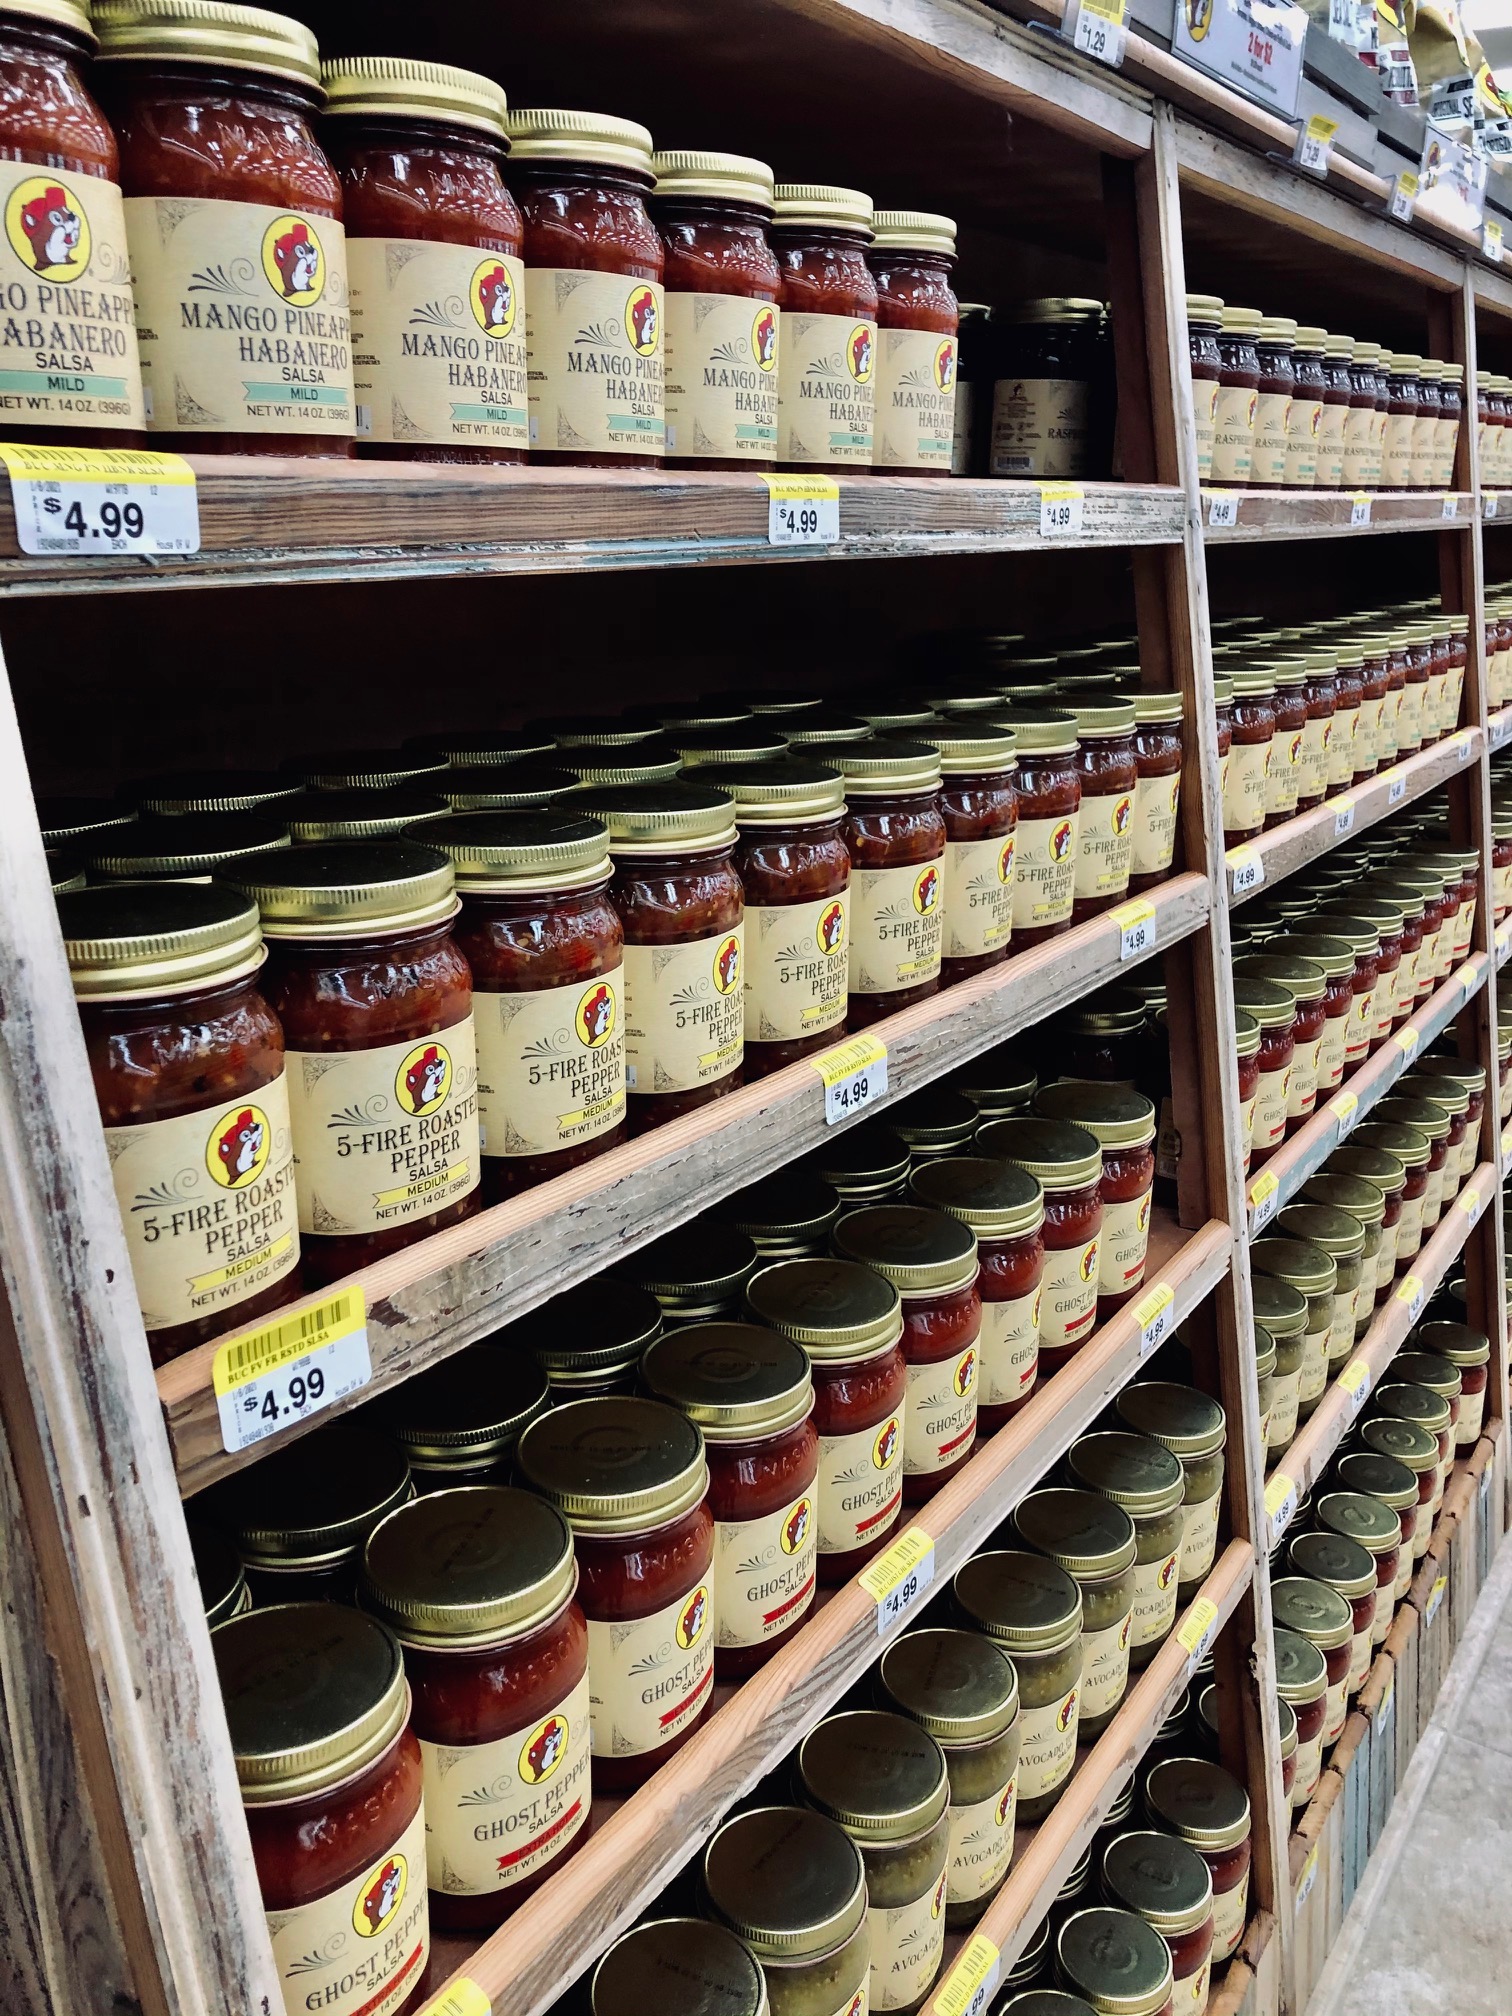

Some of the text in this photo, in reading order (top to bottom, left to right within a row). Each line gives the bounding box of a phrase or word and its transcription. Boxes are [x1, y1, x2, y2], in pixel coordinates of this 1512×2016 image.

[1082, 26, 1106, 53] $1.29
[180, 302, 278, 333] MANGO
[239, 336, 348, 371] HABANERO
[402, 333, 480, 360] MANGO
[35, 352, 94, 372] SALSA
[567, 351, 631, 376] MANGO
[47, 376, 85, 392] MILD
[282, 366, 326, 384] SALSA
[703, 367, 756, 390] MANGO
[290, 387, 319, 401] MILD
[481, 390, 513, 405] SALSA
[800, 380, 851, 401] MANGO
[892, 391, 937, 410] MANGO
[26, 397, 55, 411] WT.
[58, 399, 73, 411] 14
[247, 405, 272, 417] NET
[275, 405, 296, 418] WT.
[298, 407, 309, 418] 14
[487, 408, 508, 420] MILD
[631, 403, 656, 416] SALSA
[452, 423, 502, 435] NET WT. 14
[636, 419, 652, 430] MILD
[755, 413, 773, 425] SALSA
[849, 422, 868, 433] SALSA
[608, 432, 625, 442] NET
[736, 440, 750, 449] NET
[829, 447, 842, 455] NET
[43, 497, 144, 538] $4.99
[779, 508, 818, 534] $4.99
[1046, 507, 1071, 526] $4.99
[1083, 839, 1117, 856] 5-FIRE
[1017, 866, 1055, 883] 5-FIRE
[1236, 868, 1255, 886] $4.99
[969, 889, 1002, 908] 5-FIRE
[1049, 891, 1067, 901] SALSA
[1032, 913, 1044, 922] NET
[878, 922, 920, 941] 5-FIRE
[1125, 928, 1145, 950] $4.99
[913, 955, 935, 970] MEDIUM
[915, 944, 935, 960] SALSA
[780, 959, 825, 984] 5-FIRE
[811, 967, 846, 997] PEPPER
[896, 973, 909, 984] NET
[820, 987, 841, 1004] SALSA
[675, 1001, 722, 1029] 5-FIRE
[818, 999, 841, 1015] MEDIUM
[709, 1006, 743, 1041] PEPPER
[801, 1020, 814, 1031] NET
[718, 1029, 739, 1048] SALSA
[716, 1041, 739, 1061] MEDIUM
[528, 1054, 588, 1086] 5-FIRE
[571, 1060, 621, 1098] PEPPER
[698, 1069, 713, 1079] NET
[584, 1087, 613, 1107] SALSA
[834, 1077, 869, 1108] $4.99
[582, 1098, 613, 1120] MEDIUM
[558, 1127, 577, 1140] NET
[578, 1123, 593, 1135] WT.
[594, 1119, 602, 1128] 14
[337, 1124, 413, 1158] 5-FIRE
[391, 1128, 461, 1174] PEPPER
[409, 1157, 449, 1182] SALSA
[407, 1172, 449, 1197] MEDIUM
[376, 1172, 471, 1220] NET WT. 14 OZ. (396G)
[143, 1197, 229, 1243] 5-FIRE
[206, 1198, 284, 1254] PEPPER
[226, 1231, 272, 1263] SALSA
[225, 1248, 272, 1280] MEDIUM
[191, 1292, 217, 1309] NET
[218, 1282, 241, 1300] WT.
[243, 1273, 256, 1288] 14
[1054, 1293, 1087, 1313] GHOST
[1145, 1318, 1164, 1342] $4.99
[227, 1369, 249, 1385] BUC
[265, 1354, 278, 1368] FR
[280, 1342, 305, 1359] RSTD
[306, 1330, 330, 1345] SLSA
[243, 1367, 326, 1422] $4.99
[926, 1408, 963, 1435] GHOST
[955, 1415, 972, 1433] SALSA
[841, 1481, 884, 1512] GHOST
[875, 1486, 895, 1508] SALSA
[856, 1532, 869, 1542] NET
[747, 1567, 794, 1602] GHOST
[784, 1573, 807, 1597] SALSA
[886, 1576, 917, 1612] $4.99
[763, 1621, 778, 1634] NET
[641, 1663, 691, 1706] GHOST
[681, 1665, 705, 1694] SALSA
[660, 1722, 676, 1737] NET
[1019, 1742, 1063, 1767] AVOCADO
[474, 1799, 541, 1843] GHOST
[528, 1801, 564, 1834] SALSA
[517, 1830, 551, 1860] EXTRA
[498, 1865, 520, 1881] NET
[520, 1854, 538, 1869] WT.
[540, 1844, 550, 1857] 14
[305, 1950, 380, 2012] GHOST
[366, 1950, 405, 1992] SALSA
